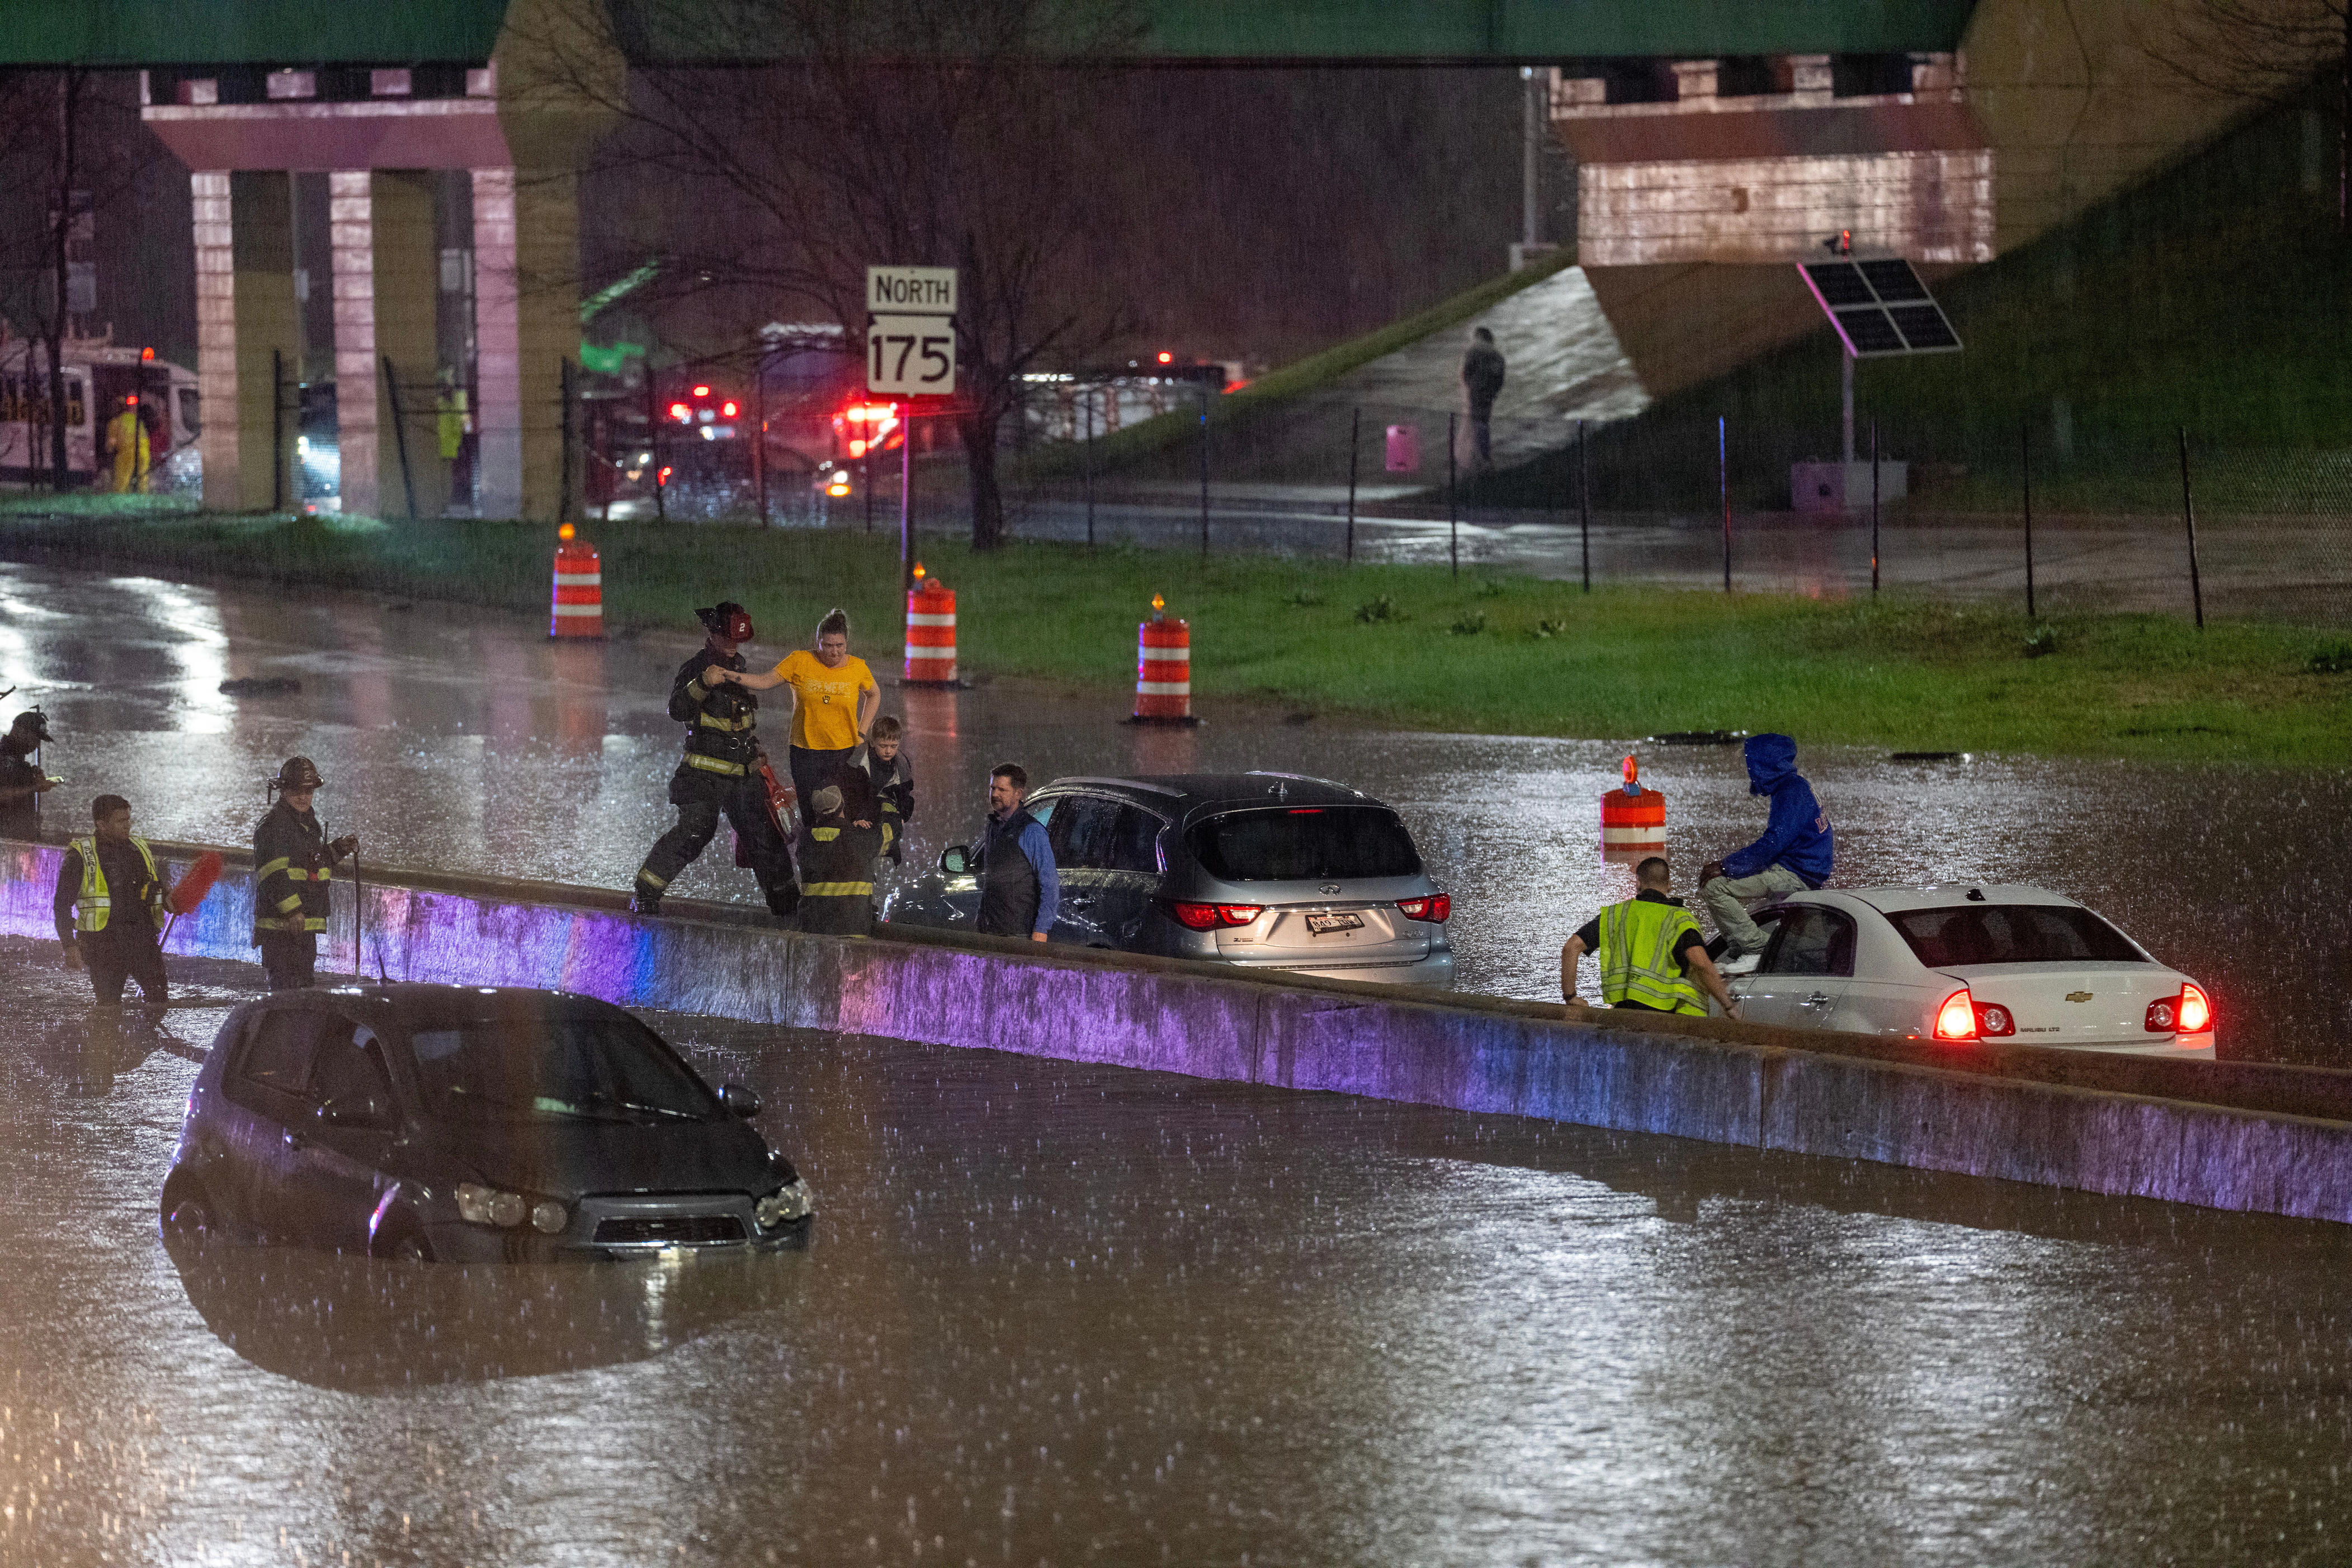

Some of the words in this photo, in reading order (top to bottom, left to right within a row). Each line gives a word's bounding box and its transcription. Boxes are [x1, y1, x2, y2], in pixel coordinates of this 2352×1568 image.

[876, 275, 949, 303] NORTH
[872, 335, 949, 382] 175
[739, 622, 745, 632] 2
